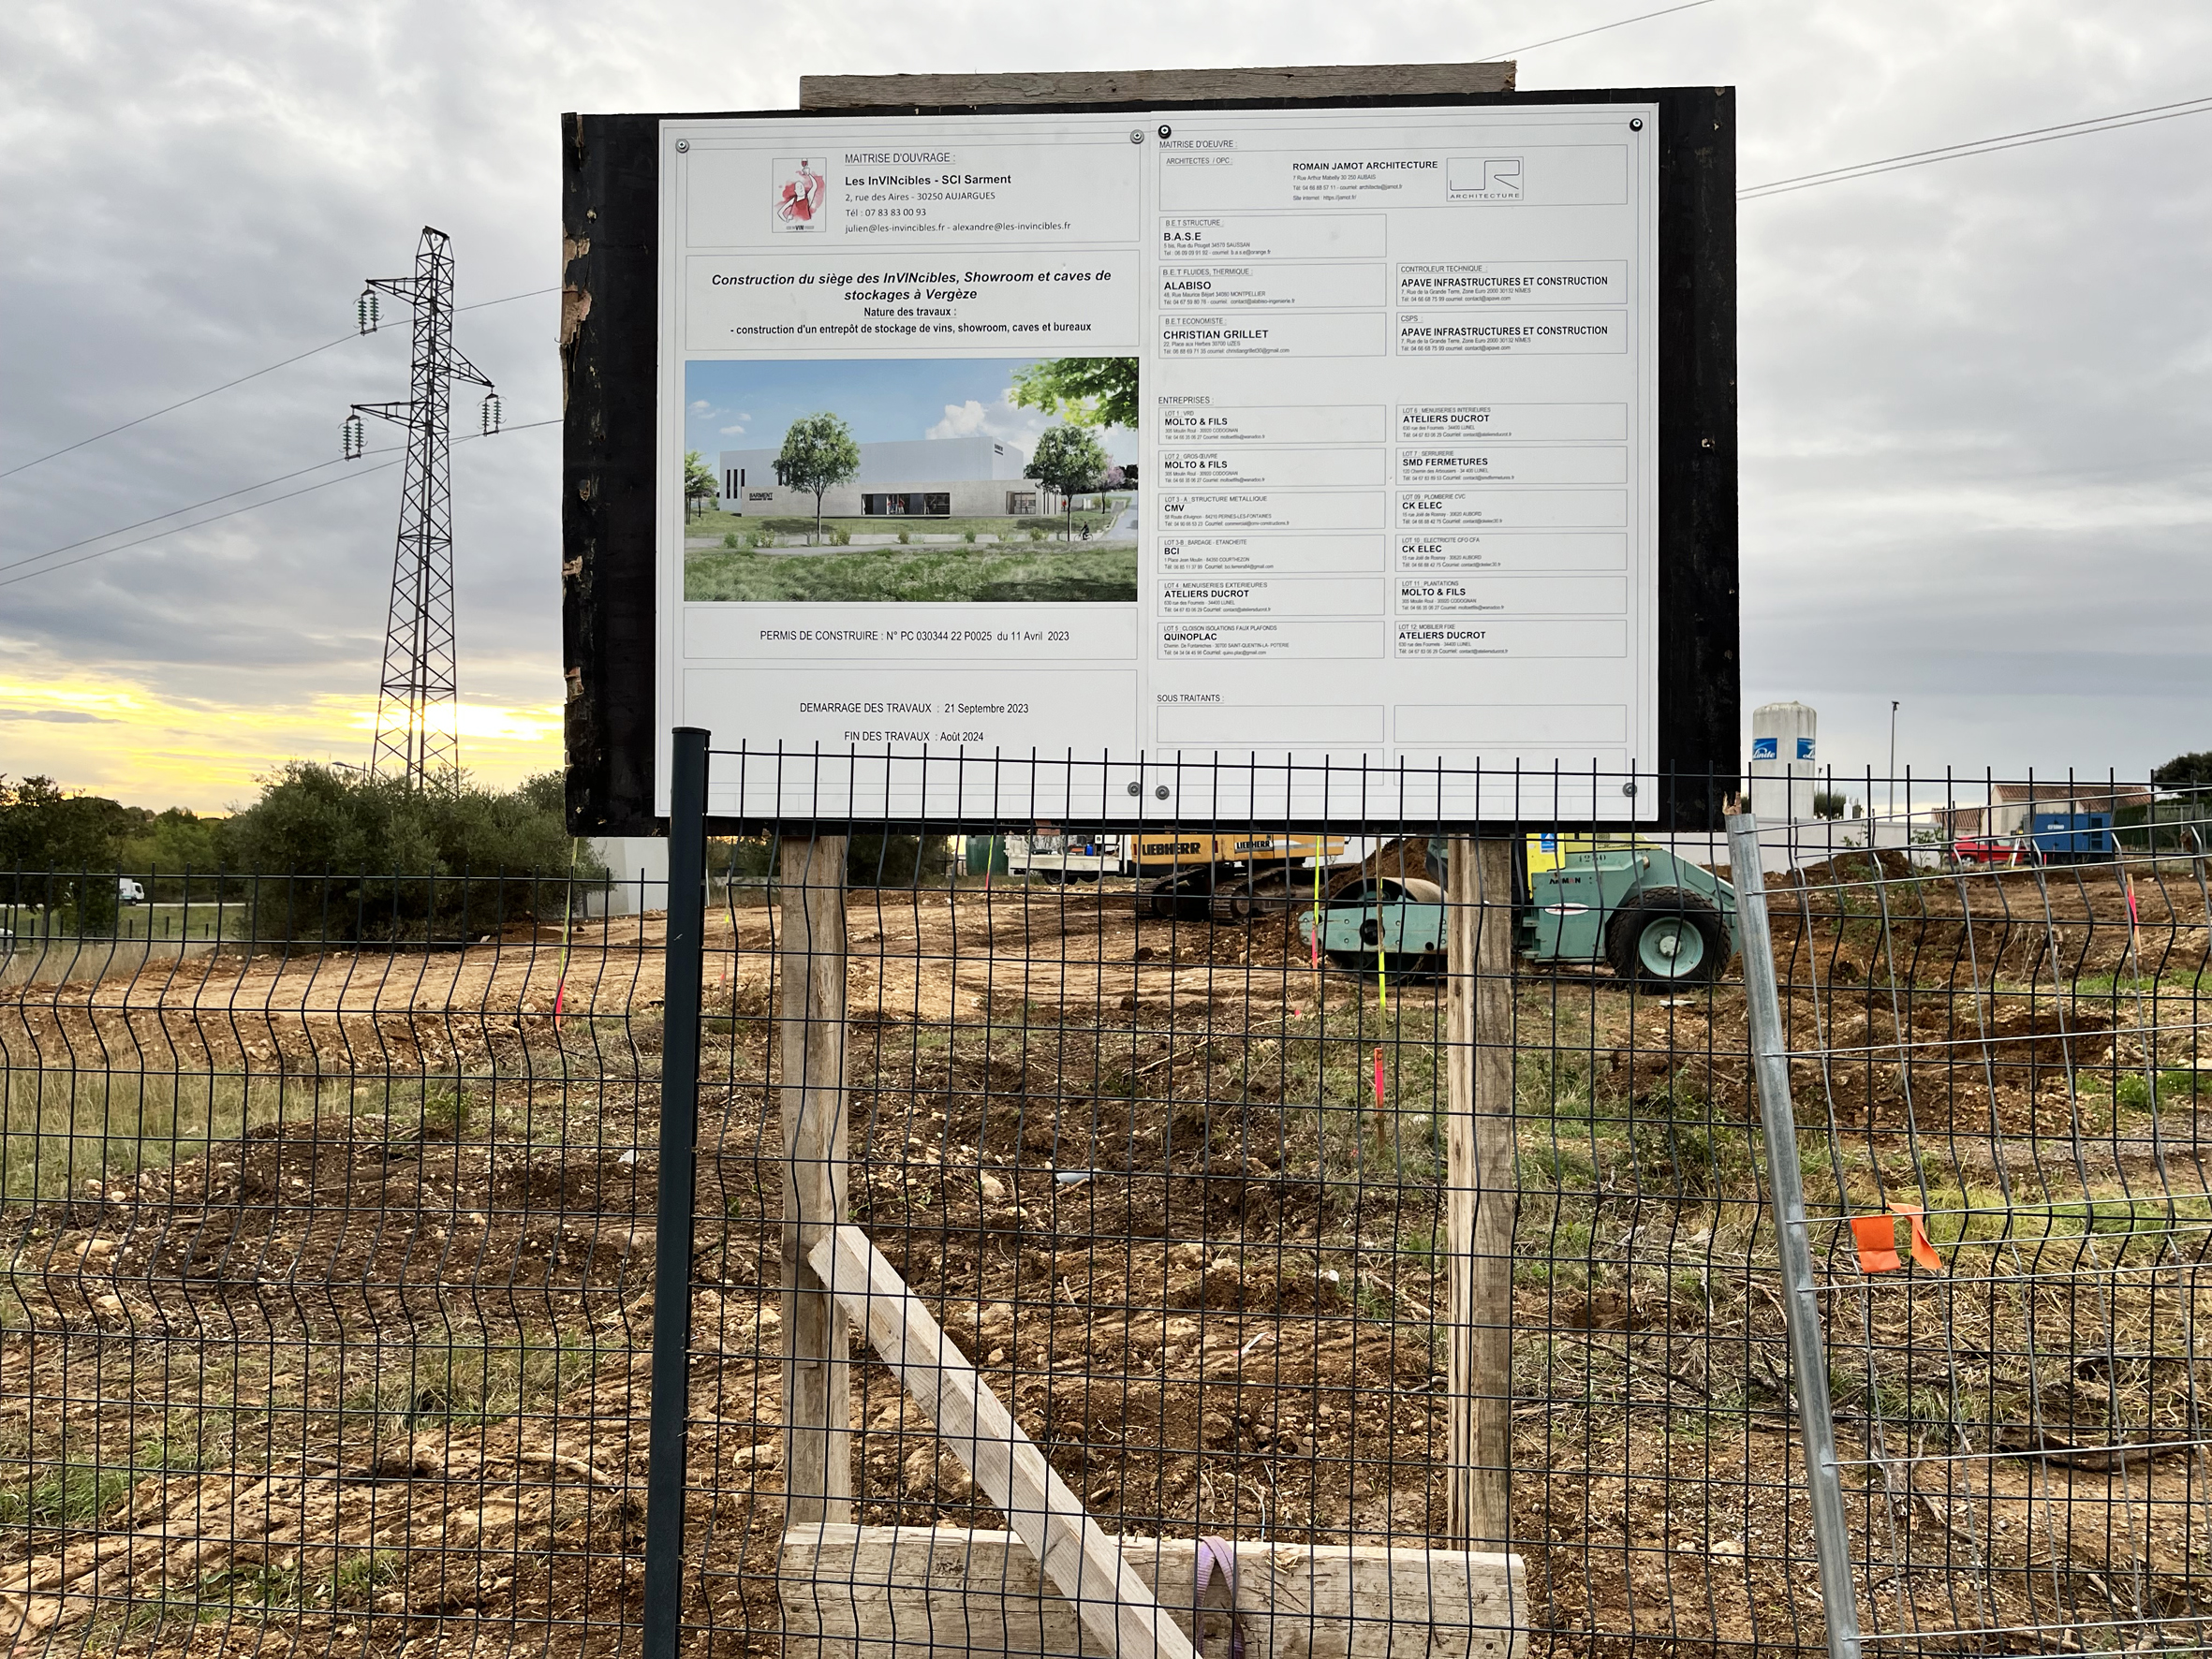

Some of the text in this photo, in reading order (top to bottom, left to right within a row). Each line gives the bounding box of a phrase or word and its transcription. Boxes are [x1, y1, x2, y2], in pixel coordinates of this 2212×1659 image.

[1196, 140, 1233, 149] D'OEUVRE
[846, 153, 950, 164] MAITRISE D'OUVRAGE
[1166, 157, 1210, 166] ARCHITECTES
[1366, 161, 1438, 169] ARCHITECTURE
[846, 174, 1010, 185] Les InVINcibles SCI Sarment
[846, 194, 852, 202] 2,
[872, 193, 887, 201] des
[945, 192, 995, 200] AUJARGUES
[846, 209, 858, 217] Tél
[846, 222, 1071, 234] julien@les-invincibles.fr alexandre@les-invincibles.fr
[1183, 219, 1220, 228] STRUCTURE
[1164, 232, 1201, 241] B.A.S.E
[1163, 268, 1249, 277] B.E.T FLUIDES, THERMIQUE
[1446, 265, 1482, 273] TECHNIQUE
[712, 274, 795, 285] Construction
[798, 273, 815, 284] du
[818, 273, 854, 286] siège
[856, 273, 880, 284] des
[883, 272, 961, 285] InVINcibles,
[964, 272, 1035, 282] Showroom
[1038, 272, 1051, 282] et
[1095, 271, 1112, 280] de
[1435, 277, 1521, 286] INFRASTRUCTURES
[1524, 277, 1534, 286] ET
[1537, 276, 1607, 286] CONSTRUCTION
[1164, 281, 1211, 290] ALABISO
[844, 288, 978, 302] stockages à Vergèze
[864, 307, 951, 316] Nature des travaux
[1182, 317, 1223, 326] ECONOMISTE
[1401, 315, 1418, 323] CSPS
[737, 325, 794, 334] construction
[797, 325, 817, 333] d'un
[820, 324, 858, 335] entrepôt
[861, 324, 872, 333] de
[875, 324, 917, 335] stockage
[920, 323, 931, 332] de
[933, 323, 955, 333] vins,
[958, 323, 1010, 333] showroom,
[1042, 323, 1051, 331] et
[1054, 322, 1091, 331] bureaux
[1402, 326, 1607, 336] APAVE INFRASTRUCTURES ET CONSTRUCTION
[1164, 330, 1268, 339] CHRISTIAN GRILLET
[760, 631, 1069, 640] PERMIS DE CONSTRUIRE N° PC 030344 22 P0025 du 11 Avril 2023
[801, 703, 1028, 715] DEMARRAGE DES TRAVAUX 21 Septembre 2023
[845, 731, 983, 741] FIN DES TRAVAUX Août 2024
[1236, 840, 1271, 849] LIEBHERR
[1142, 843, 1201, 856] LIEBHERR
[1579, 854, 1606, 862] 120
